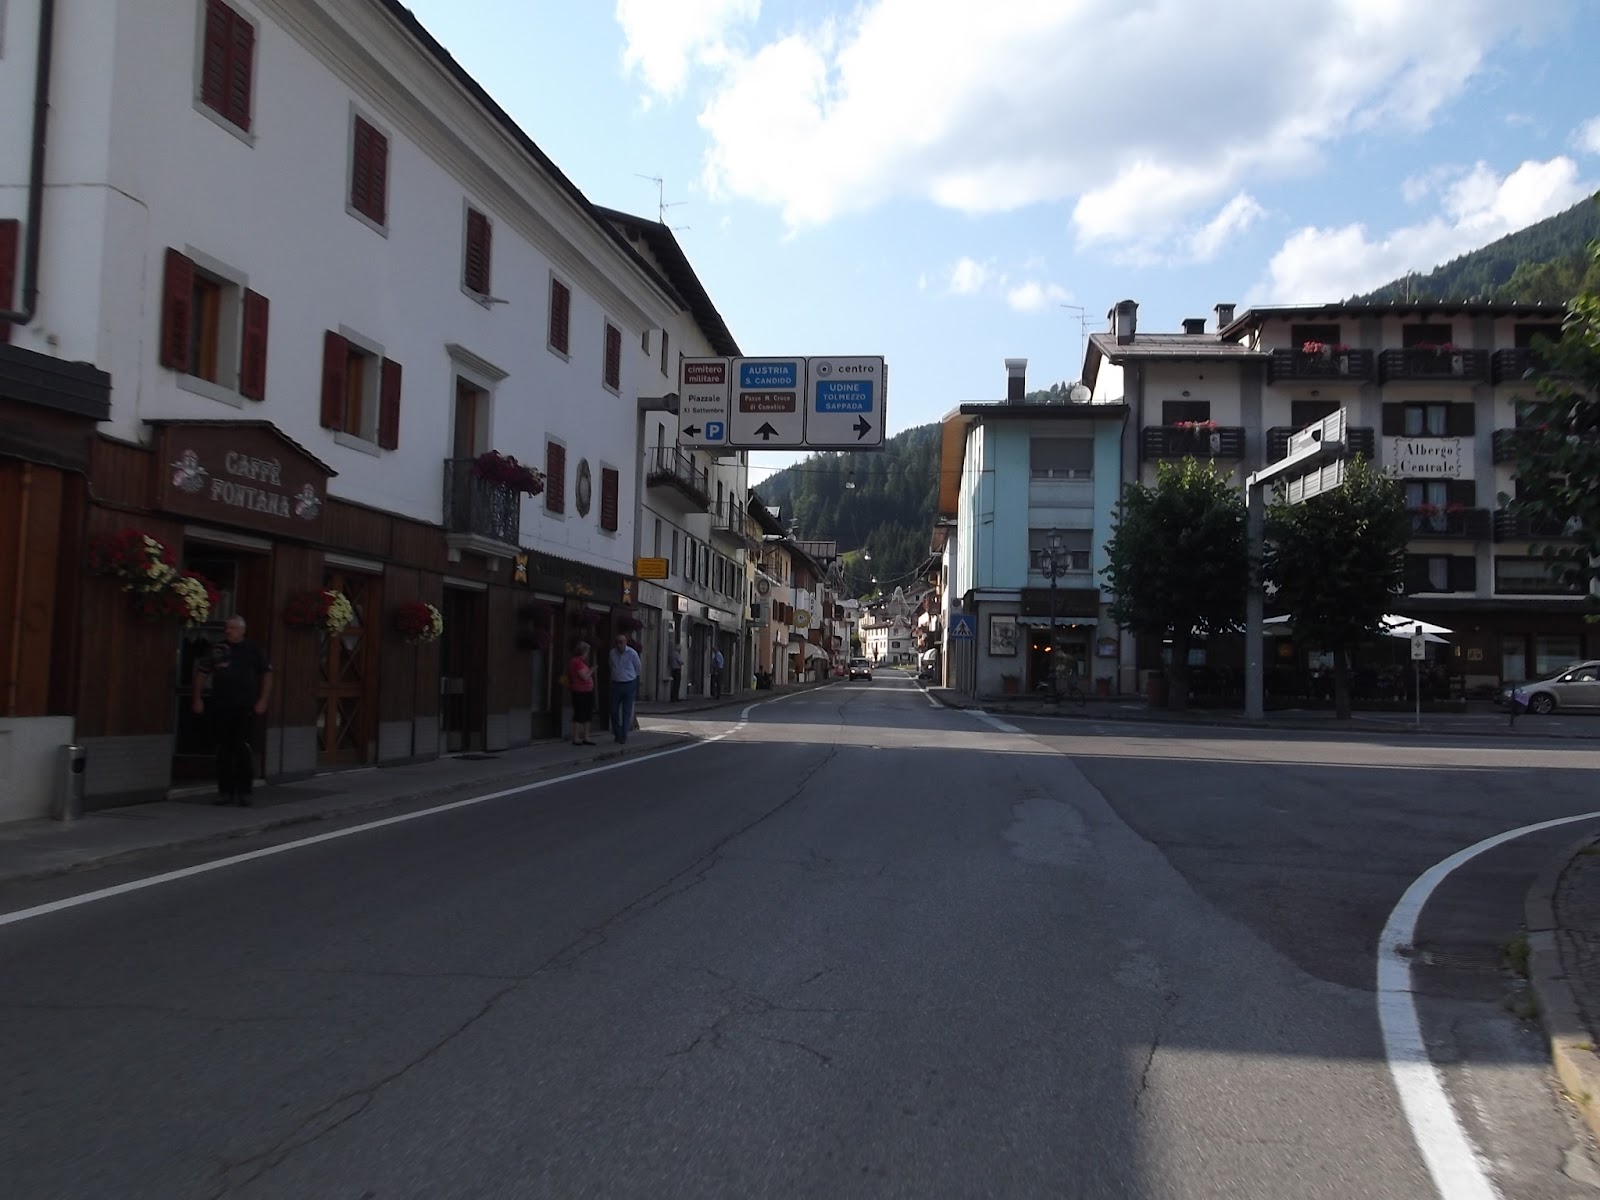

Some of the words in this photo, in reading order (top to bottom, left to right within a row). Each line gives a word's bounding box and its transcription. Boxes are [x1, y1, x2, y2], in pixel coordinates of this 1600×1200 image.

[687, 365, 722, 374] cimitero
[749, 366, 789, 374] AUSTRIA
[838, 365, 874, 373] centro
[829, 383, 859, 392] UDINE
[823, 393, 866, 401] TOLMEZZO
[825, 402, 863, 410] SAPPADA
[709, 425, 720, 438] P
[1404, 443, 1453, 458] Albergo
[1400, 460, 1454, 472] Centrale
[210, 477, 291, 518] FONTANA
